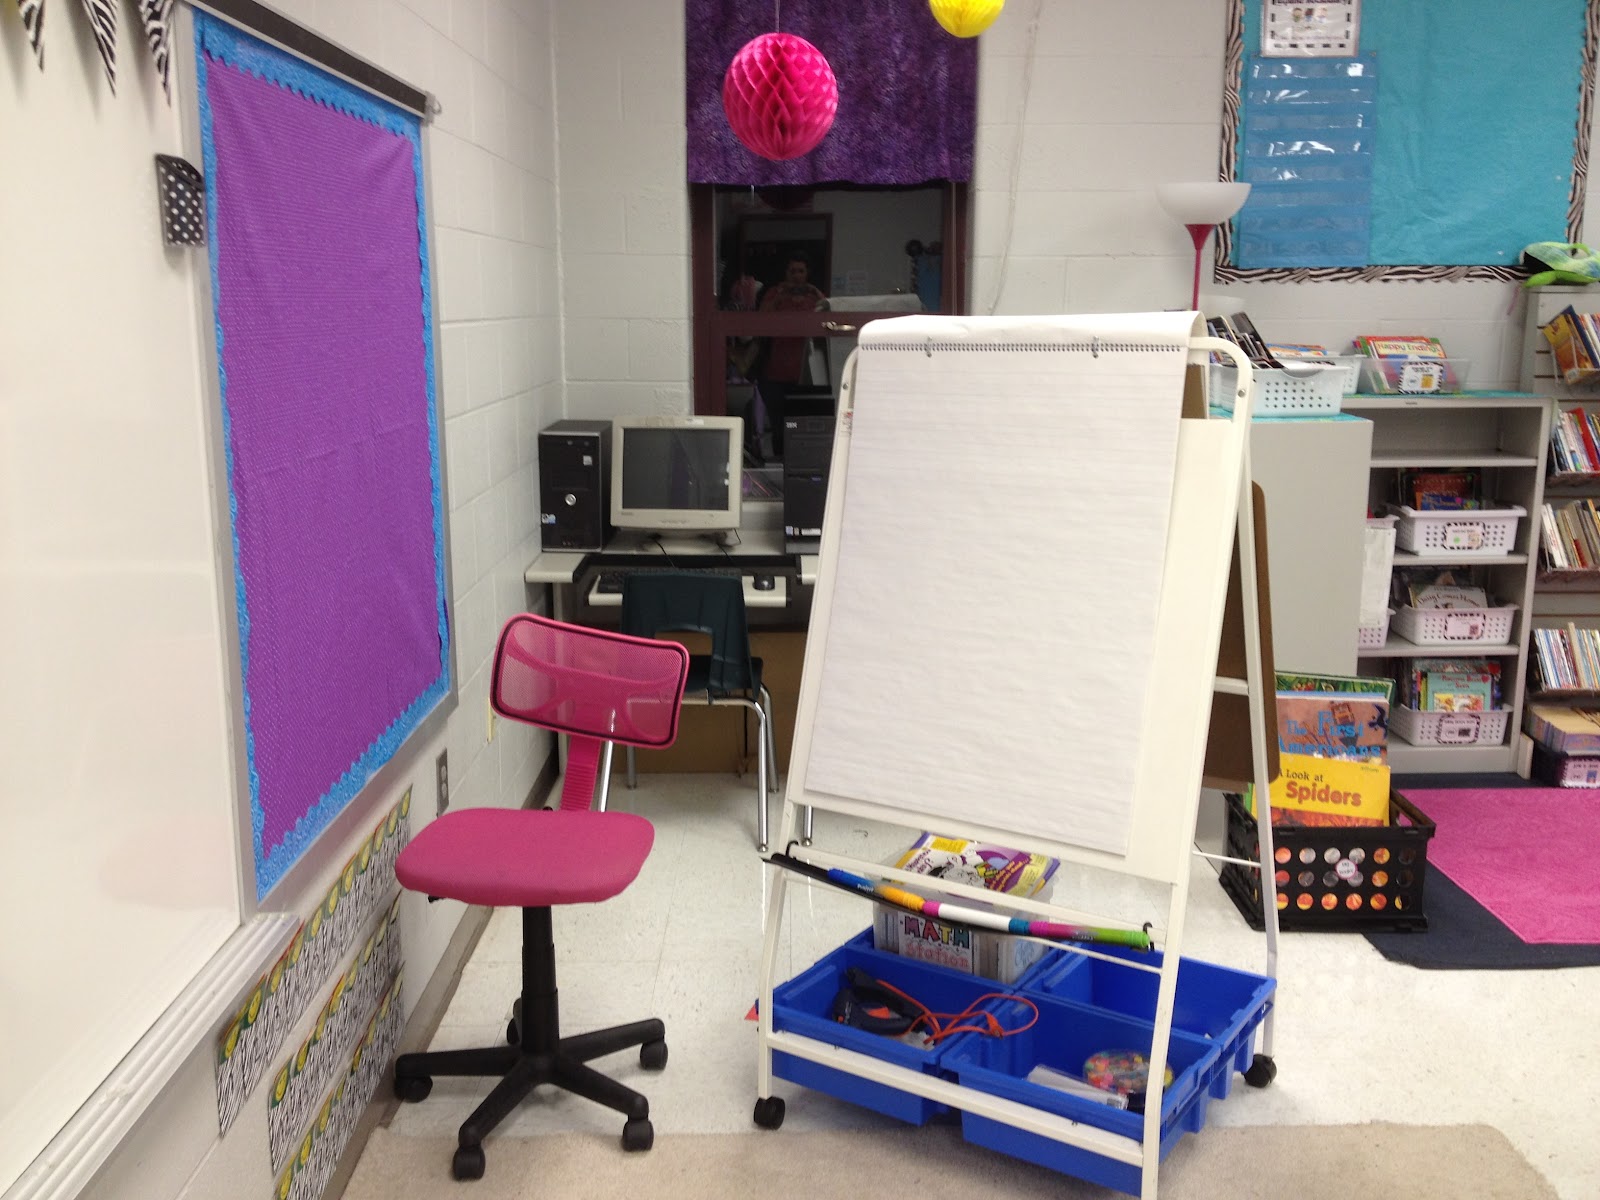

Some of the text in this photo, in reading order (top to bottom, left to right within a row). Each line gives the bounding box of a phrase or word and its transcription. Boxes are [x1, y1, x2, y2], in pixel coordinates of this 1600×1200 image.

[1287, 710, 1364, 737] The First
[1286, 769, 1310, 781] Look
[1314, 773, 1324, 782] at
[1285, 780, 1362, 807] Spiders
[904, 915, 970, 949] MATH
